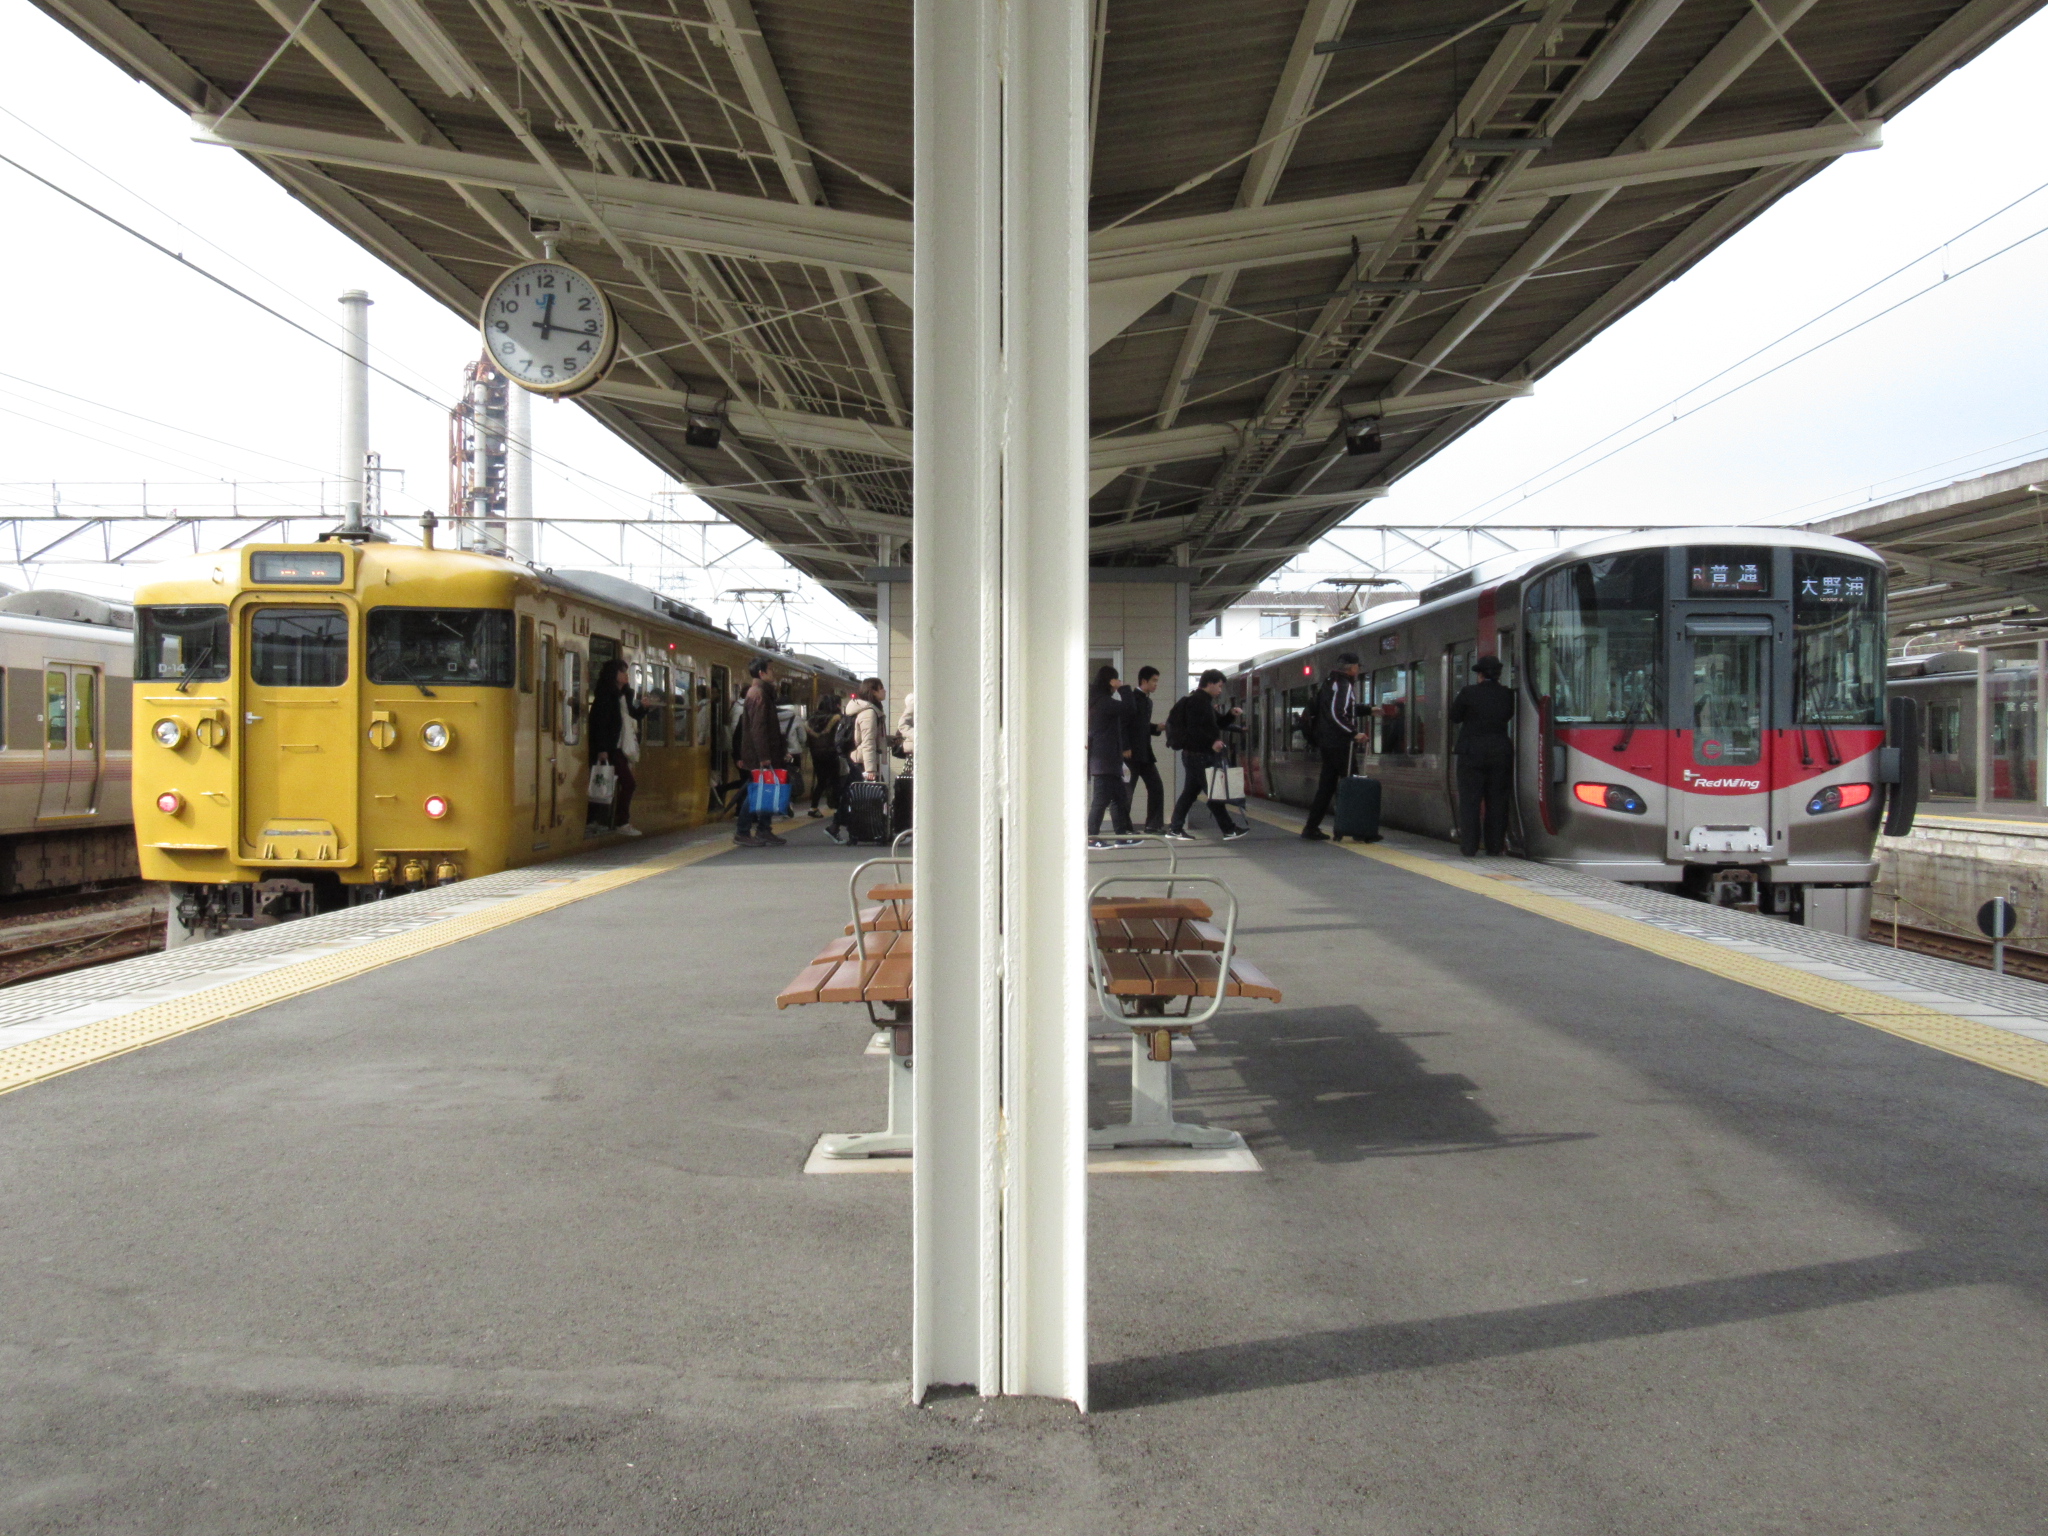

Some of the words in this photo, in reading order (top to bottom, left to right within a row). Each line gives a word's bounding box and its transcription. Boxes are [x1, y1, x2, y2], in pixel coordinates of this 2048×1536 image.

[537, 275, 555, 288] 12
[565, 281, 571, 293] 1
[514, 284, 530, 296] 11
[501, 300, 519, 313] 10
[578, 298, 592, 312] 2
[495, 320, 509, 333] 9
[584, 320, 598, 333] 3
[501, 341, 516, 355] 8
[577, 340, 592, 353] 4
[519, 359, 533, 373] 7
[563, 358, 577, 371] 5
[540, 365, 555, 379] 6
[1710, 564, 1758, 583] 普通
[1801, 576, 1865, 597] 大野浦
[158, 663, 186, 673] D-14
